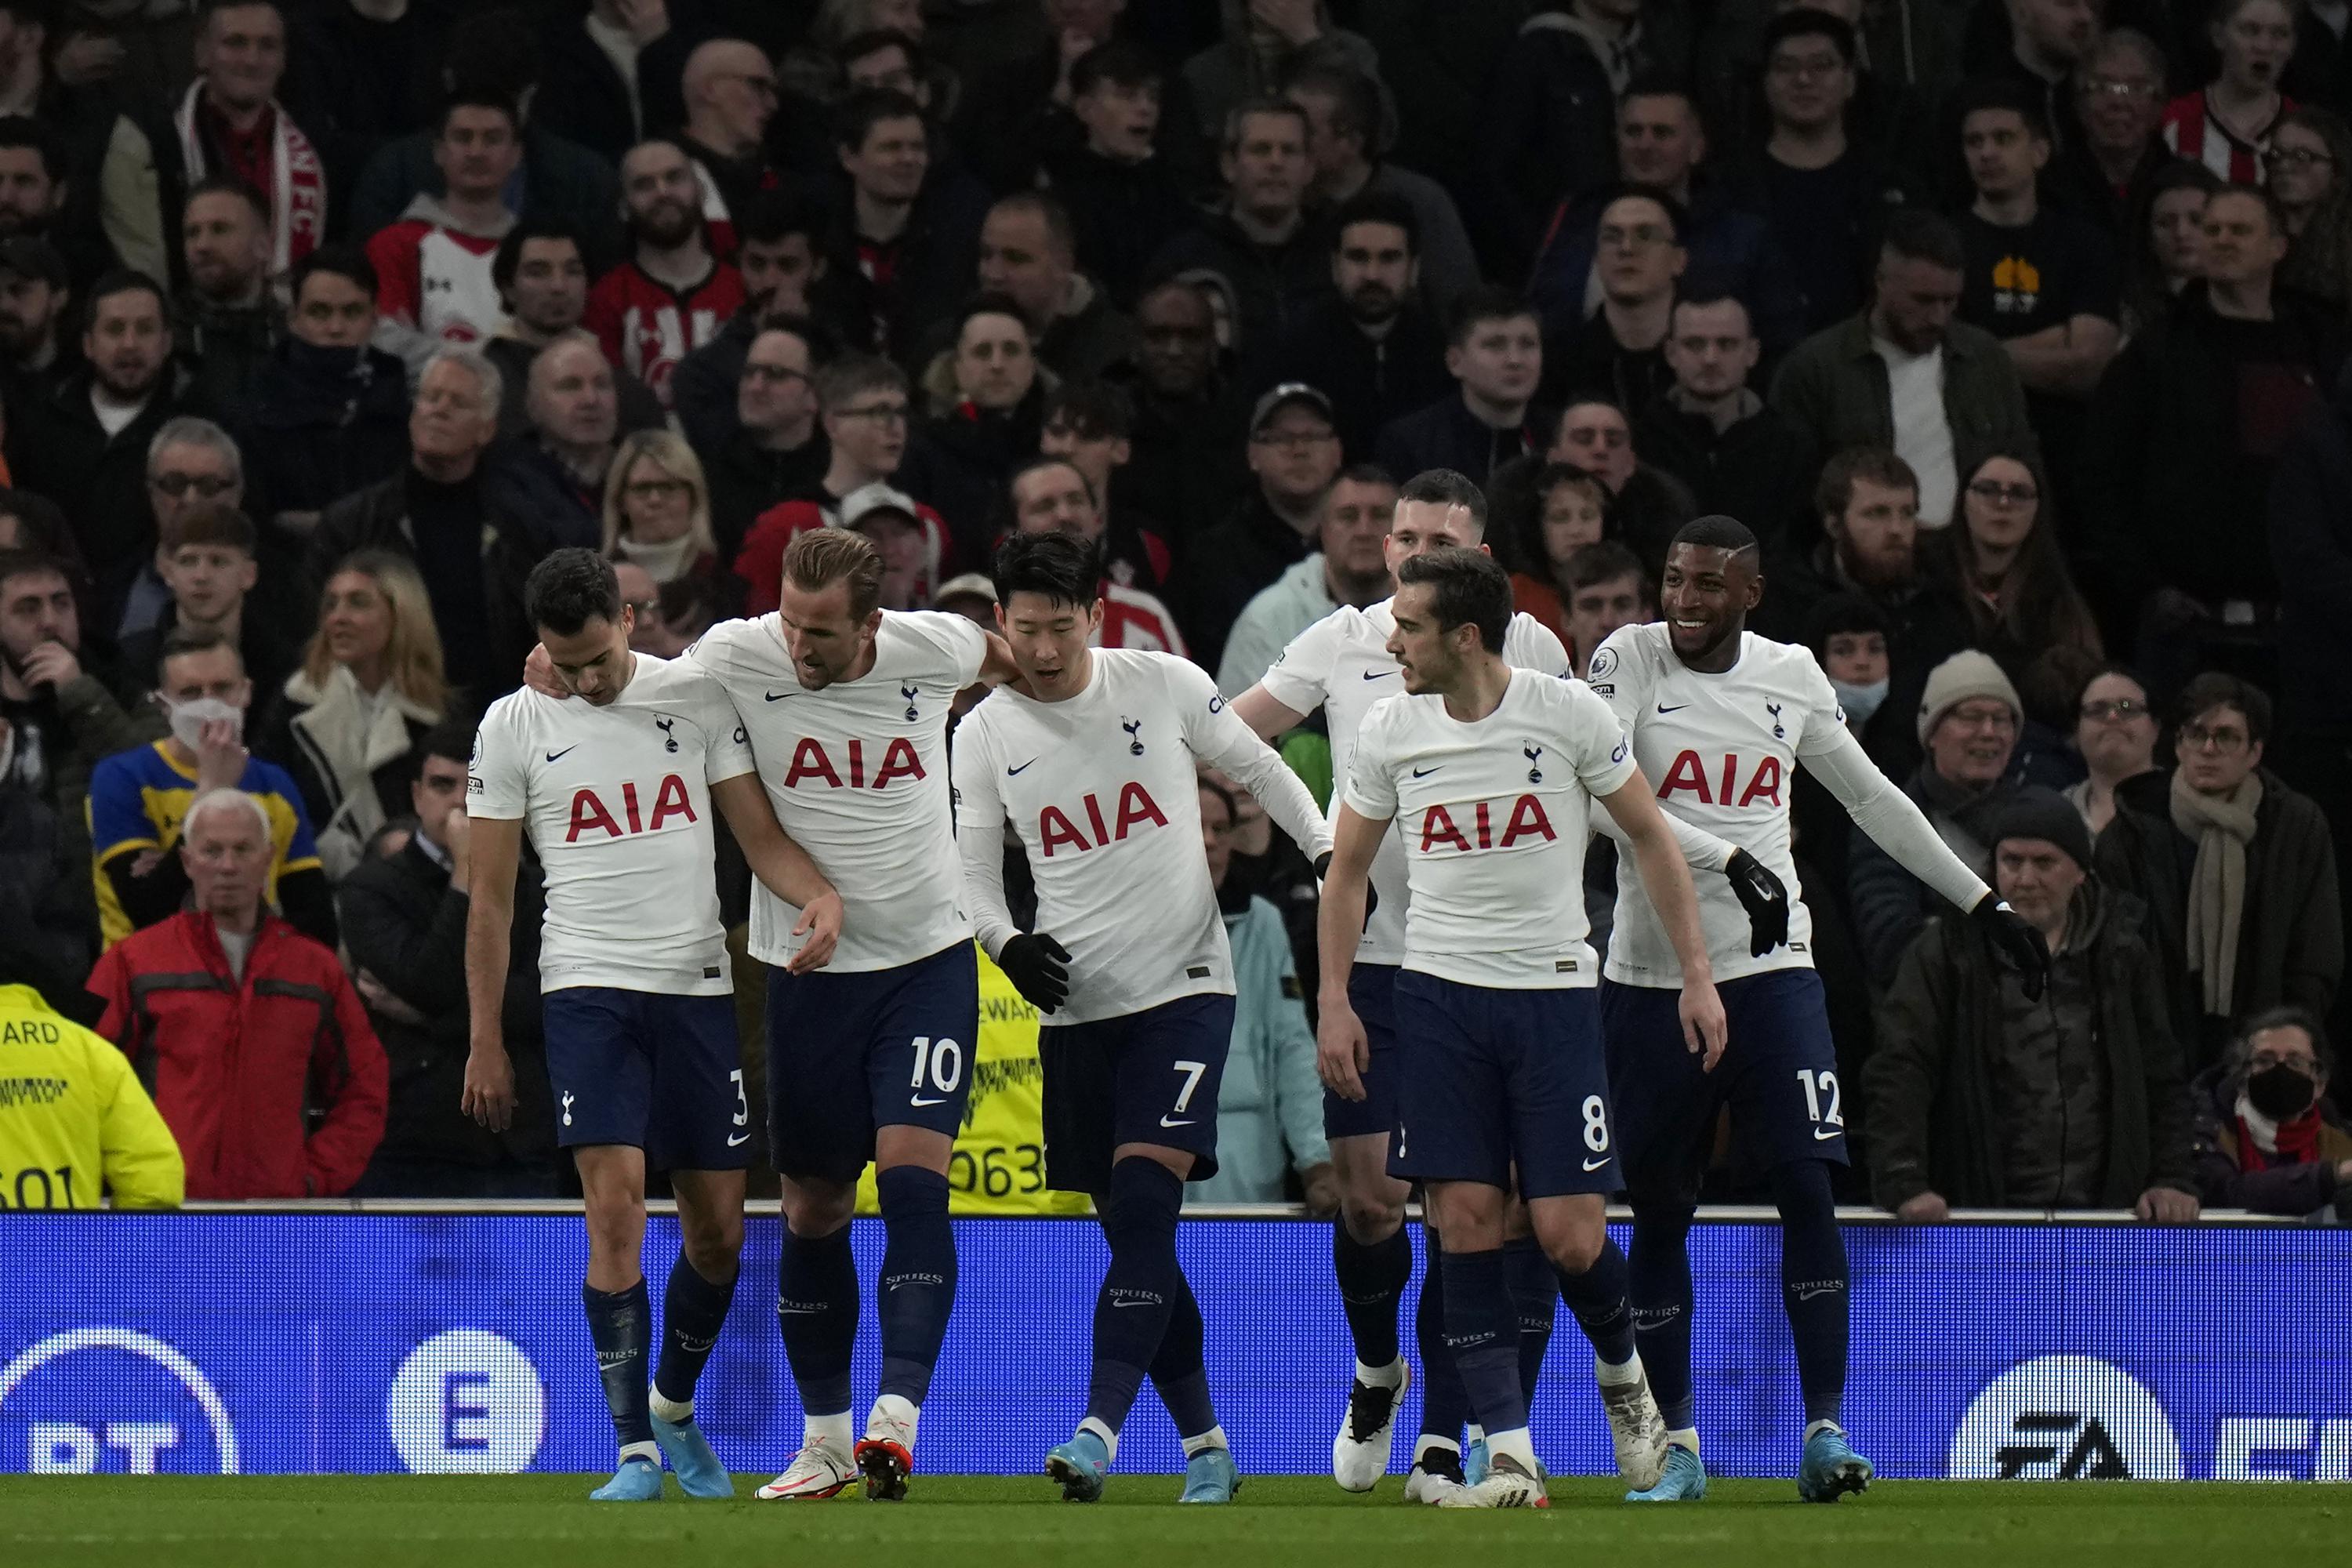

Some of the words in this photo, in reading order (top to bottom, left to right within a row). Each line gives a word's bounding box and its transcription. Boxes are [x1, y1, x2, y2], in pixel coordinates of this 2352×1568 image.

[786, 738, 927, 788] AIA
[1657, 750, 1780, 807] AIA
[565, 774, 697, 843] AIA
[1040, 782, 1169, 857] AIA
[1420, 794, 1558, 852] AIA
[910, 1036, 962, 1092] 10
[1173, 1060, 1207, 1112] 7
[730, 1069, 748, 1126] 3
[1582, 1094, 1609, 1152] 8
[1797, 1069, 1844, 1127] 12
[886, 1272, 944, 1285] SPURS
[1109, 1288, 1163, 1305] SPURS
[1791, 1279, 1844, 1292] SPURS
[1631, 1304, 1680, 1318] SPURS
